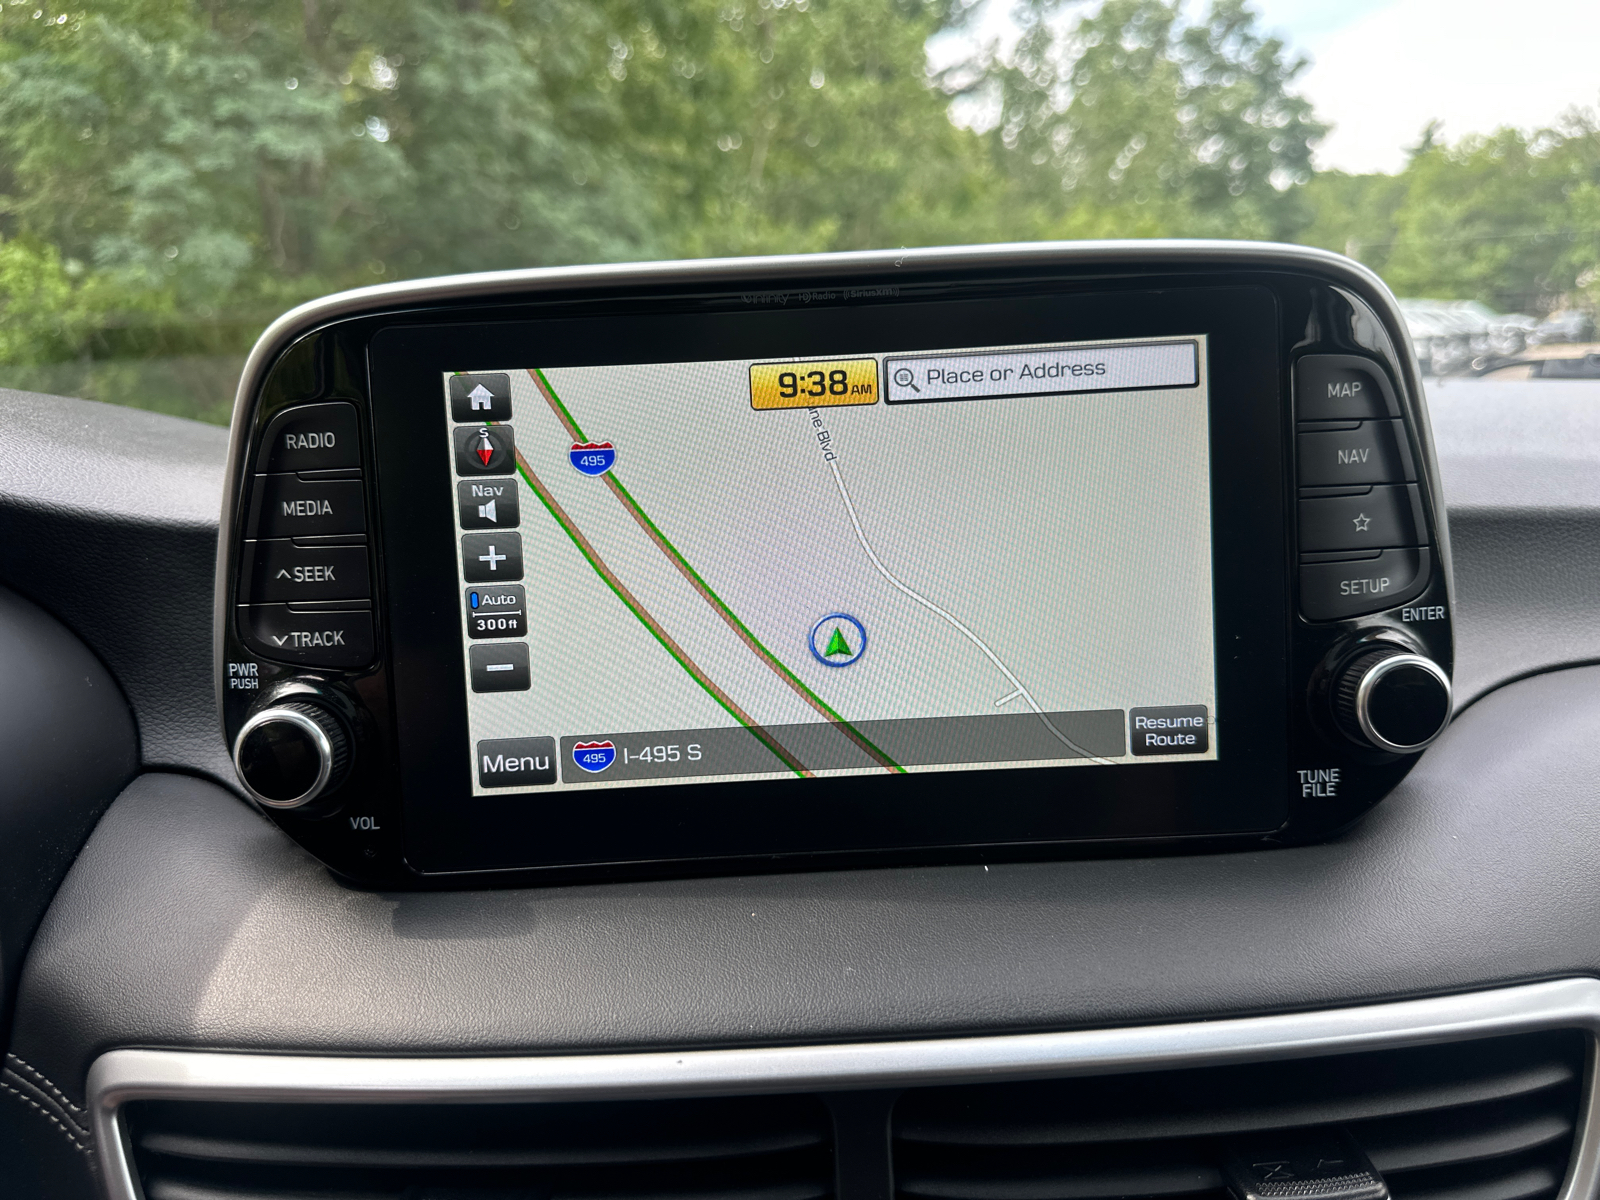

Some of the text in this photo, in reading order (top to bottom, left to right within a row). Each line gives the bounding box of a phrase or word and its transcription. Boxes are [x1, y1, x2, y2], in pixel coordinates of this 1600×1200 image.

[812, 291, 836, 301] Radio
[926, 360, 1106, 386] Place or Address
[778, 370, 872, 398] 9:38 AM
[1327, 382, 1362, 398] MAP
[479, 427, 489, 438] S
[286, 432, 335, 450] RADIO
[816, 430, 837, 462] Blvd
[580, 456, 606, 467] 495
[1338, 448, 1369, 464] NAV
[472, 484, 504, 498] Nav
[282, 499, 333, 518] MEDIA
[294, 565, 335, 582] SEEK
[1340, 578, 1390, 596] SETUP
[482, 594, 516, 606] Auto
[1402, 606, 1444, 622] ENTER
[292, 630, 344, 648] TRACK
[228, 662, 259, 677] PWR
[230, 678, 259, 690] PUSH
[1134, 714, 1204, 730] Resume
[1145, 732, 1196, 747] Route
[582, 744, 702, 764] 495 I-495 S
[482, 754, 550, 774] Menu
[1297, 768, 1339, 783] TUNE
[1302, 783, 1336, 798] FILE
[350, 816, 380, 830] VOL
